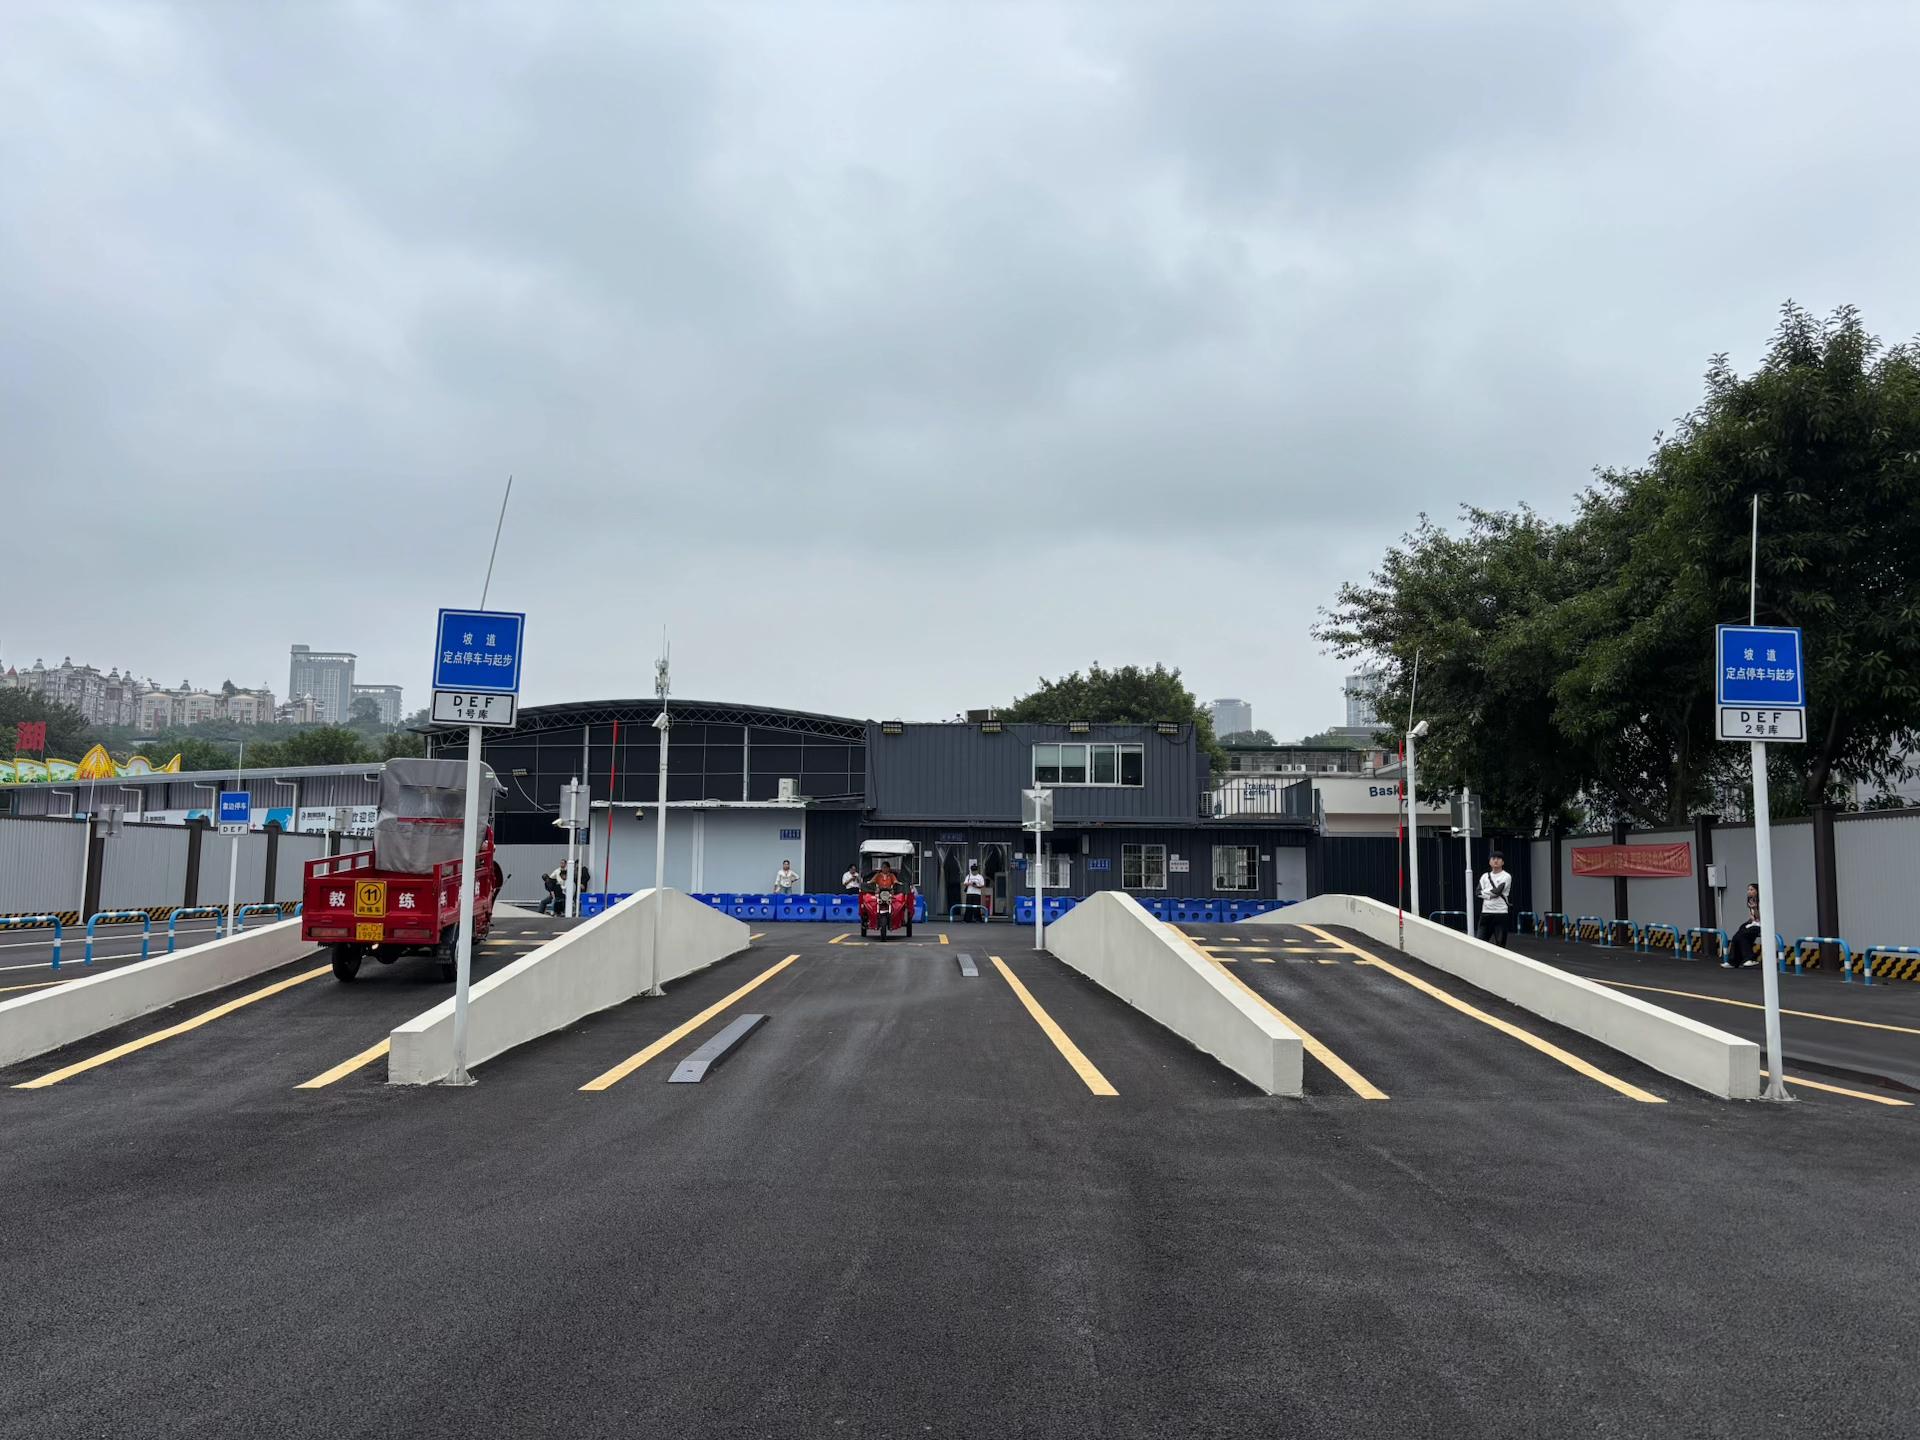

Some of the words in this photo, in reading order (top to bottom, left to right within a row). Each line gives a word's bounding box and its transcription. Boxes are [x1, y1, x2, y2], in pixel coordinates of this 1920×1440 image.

[463, 632, 496, 647] 坡道
[442, 650, 513, 667] 定点停车与起步
[1743, 648, 1776, 662] 坡道
[1726, 667, 1795, 681] 定点停车与起步
[457, 708, 488, 720] 1号库
[1745, 724, 1778, 735] 2号库
[329, 891, 346, 907] 教
[399, 893, 416, 909] 练
[364, 889, 378, 901] 11
